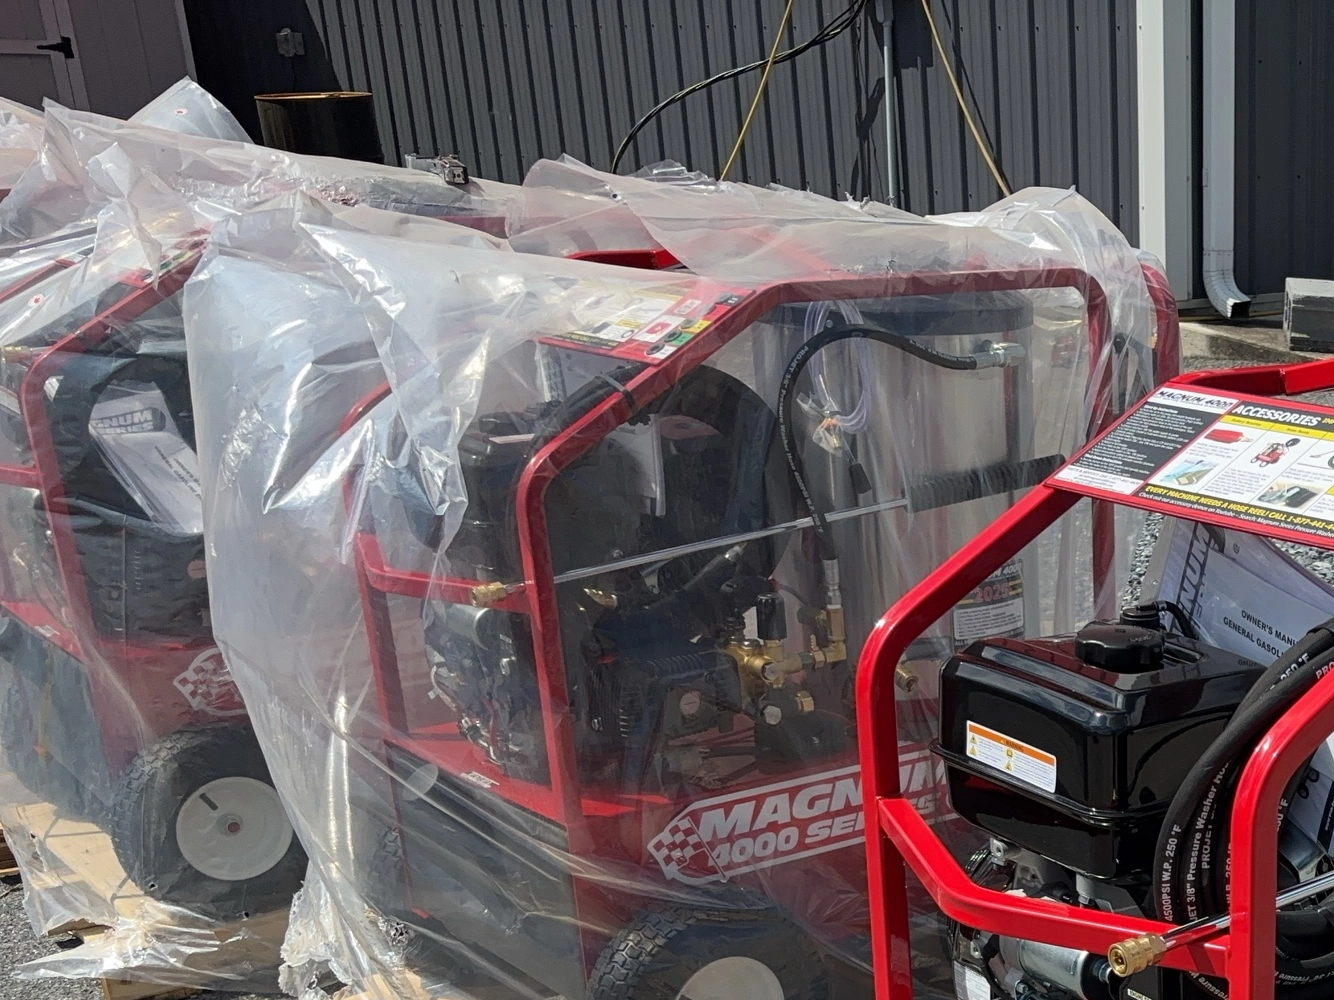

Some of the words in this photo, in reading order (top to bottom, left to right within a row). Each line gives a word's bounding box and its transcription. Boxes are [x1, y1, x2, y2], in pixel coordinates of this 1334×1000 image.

[1159, 391, 1205, 404] MAGNUM
[1205, 398, 1233, 408] 4000
[1232, 405, 1321, 426] ACCESSORIES
[1145, 485, 1168, 495] EVERY
[1166, 488, 1200, 501] MACHINE
[1199, 496, 1222, 507] NEEDS
[1229, 502, 1248, 512] HOSE
[1247, 506, 1269, 517] REEL!
[1269, 510, 1287, 521] CALL
[1169, 498, 1192, 508] accessory
[1215, 509, 1235, 517] Youtube
[1257, 516, 1280, 526] Magnum
[1279, 522, 1295, 530] Series
[1294, 525, 1317, 534] Pressure
[975, 583, 1009, 603] 2025
[1223, 616, 1255, 643] GENERAL
[1241, 609, 1274, 636] OWNER'S
[1298, 653, 1309, 664] °F
[1195, 787, 1217, 830] Washer
[1171, 824, 1182, 837] °F
[709, 826, 799, 868] 4000
[1166, 838, 1178, 857] 250
[1187, 831, 1202, 881] Pressure
[1162, 860, 1172, 882] W.P.
[1162, 883, 1173, 922] 4500PSI
[1186, 884, 1196, 903] 3/8"
